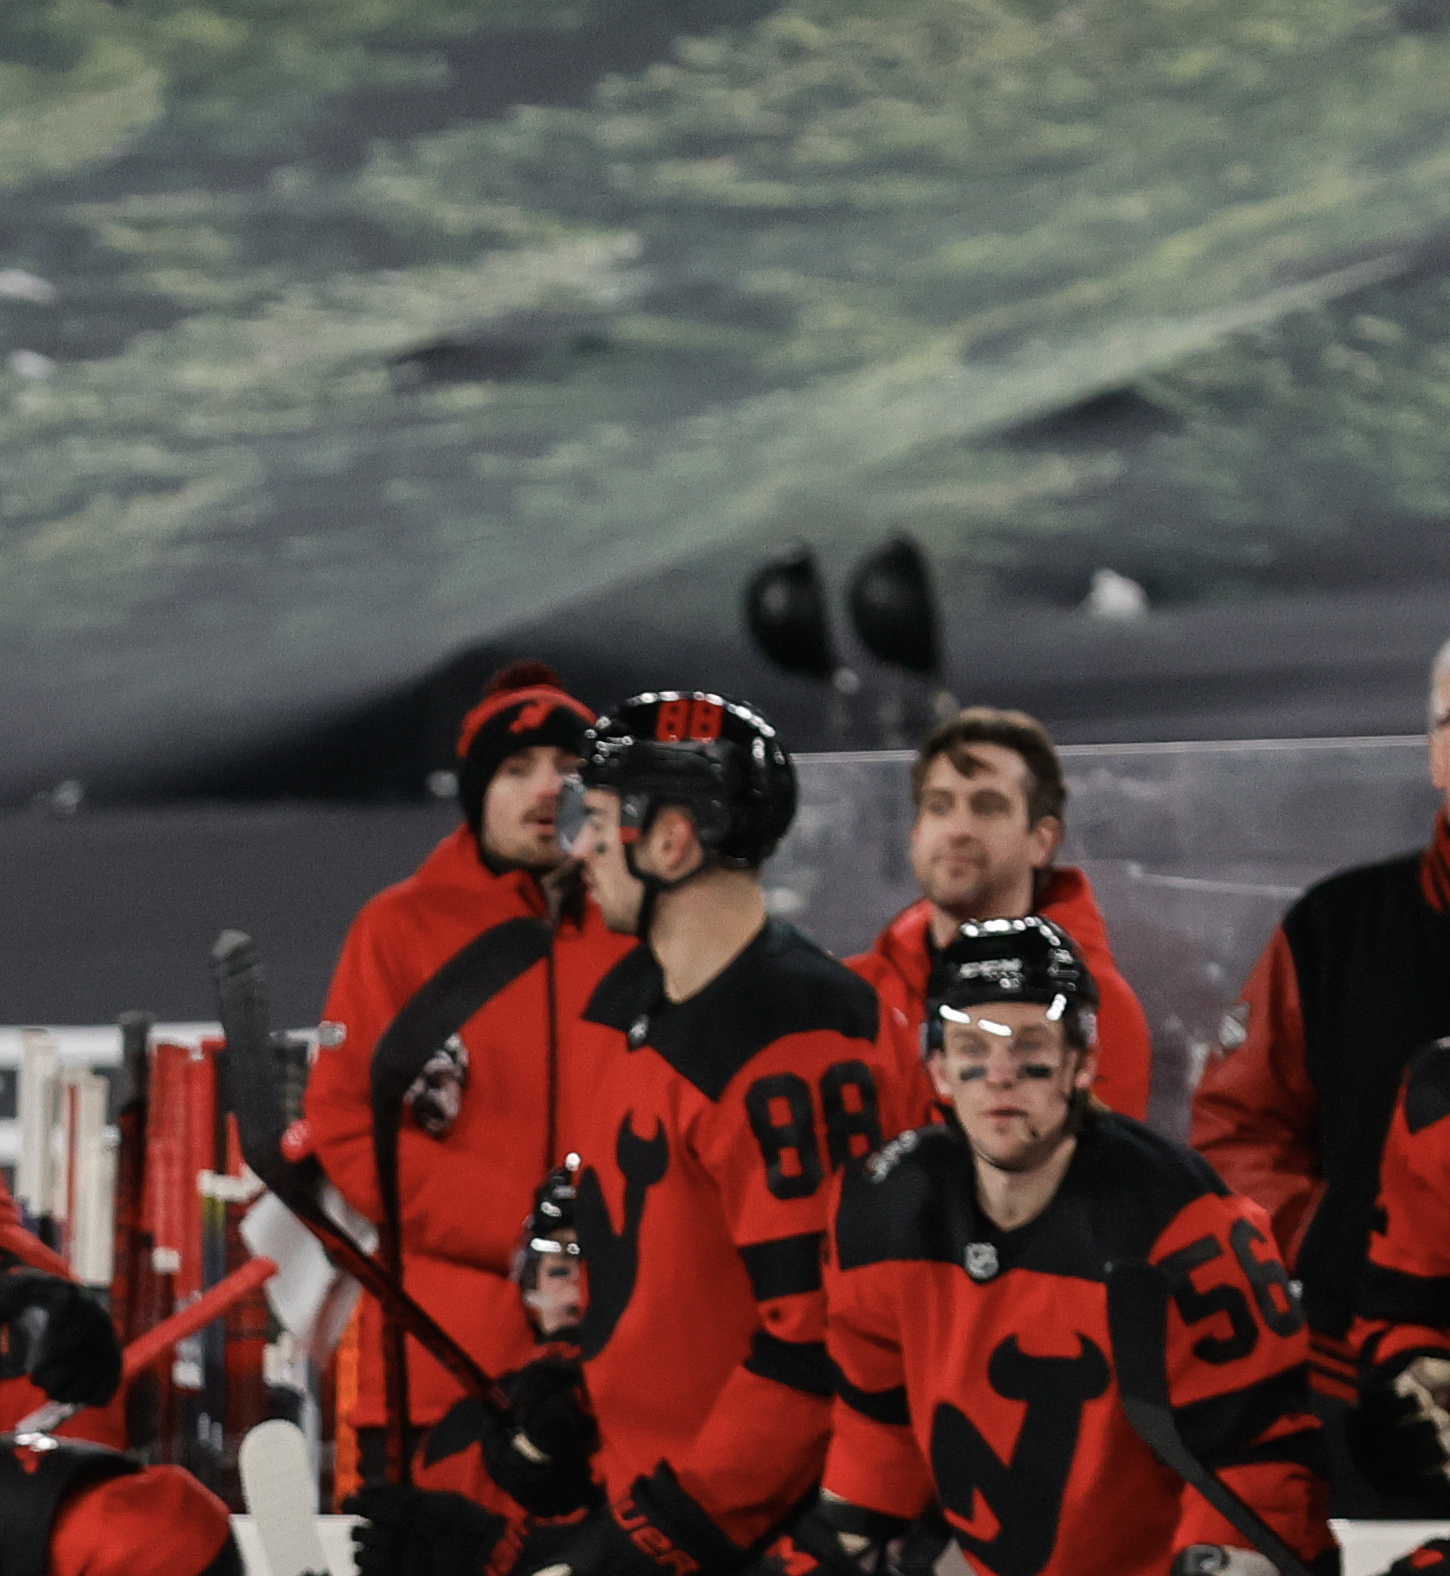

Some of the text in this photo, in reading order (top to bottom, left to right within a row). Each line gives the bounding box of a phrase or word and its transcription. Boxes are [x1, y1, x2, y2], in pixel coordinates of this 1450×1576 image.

[655, 698, 723, 743] 88
[746, 1060, 882, 1200] 88
[1157, 1217, 1306, 1365] 56
